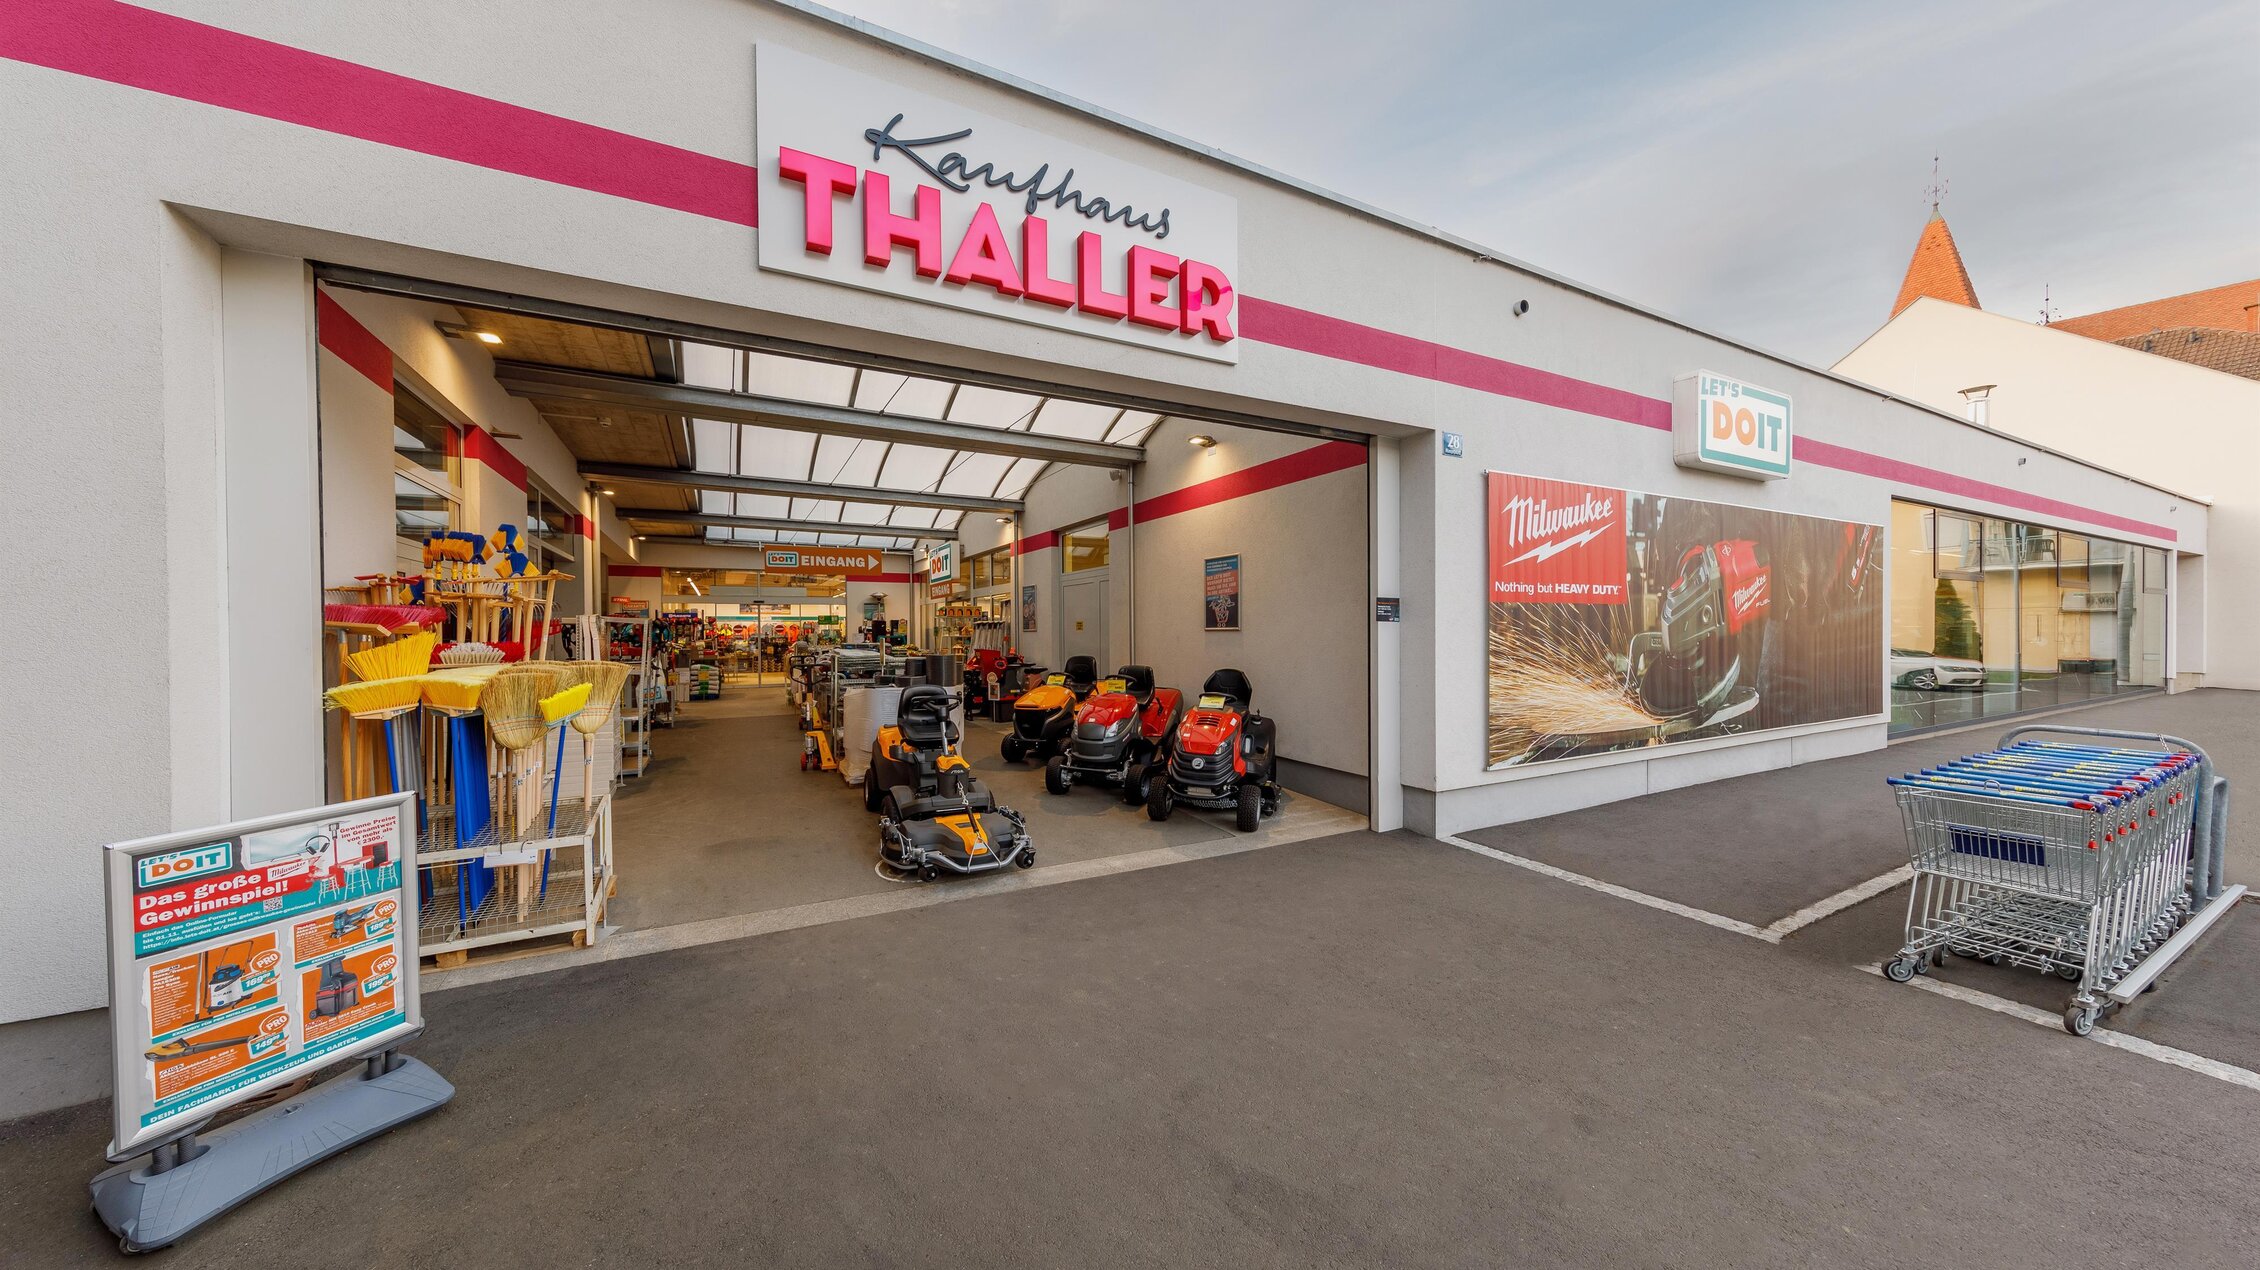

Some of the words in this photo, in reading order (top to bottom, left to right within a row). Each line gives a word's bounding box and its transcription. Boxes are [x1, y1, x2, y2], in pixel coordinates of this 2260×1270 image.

[864, 113, 1170, 238] Kaufhaus
[779, 146, 1235, 343] THALLER
[1701, 377, 1739, 398] LET'S
[1713, 400, 1782, 452] DOIT
[1448, 434, 1459, 449] 28
[1501, 493, 1614, 548] Milwaukee
[801, 555, 866, 568] EINGANG
[931, 554, 949, 574] DOIT
[931, 583, 950, 596] EINGANG
[1495, 581, 1535, 595] Nothing
[1537, 582, 1553, 593] but
[1555, 584, 1590, 594] HEAVY
[1732, 575, 1767, 610] Milwaukee
[340, 820, 371, 834] Gewinne
[373, 815, 397, 825] Preise
[353, 820, 397, 836] Gesamtwert
[347, 834, 360, 843] von
[362, 830, 380, 840] mehr
[140, 853, 178, 867] LET'S
[152, 852, 221, 878] DOIT
[271, 861, 306, 878] Milwaukee
[140, 891, 187, 910] Das
[194, 875, 262, 900] große
[140, 880, 288, 925] Gewinnspiel!
[379, 902, 395, 915] PRO
[142, 928, 170, 938] Einfach
[186, 911, 238, 927] Online-Formular
[181, 923, 212, 934] ausfüllen
[256, 953, 279, 968] PRO
[377, 957, 396, 971] PRO
[172, 1025, 200, 1036] EXKLUSIV
[226, 1006, 257, 1019] MITGLIEDER
[266, 1015, 287, 1030] PRO
[150, 1108, 175, 1123] DEIN
[178, 1085, 236, 1112] FACHMARKT
[238, 1076, 257, 1088] FÜR
[258, 1057, 305, 1079] WERKZEUG
[307, 1049, 325, 1060] UND
[327, 1036, 359, 1052] GARTEN.
